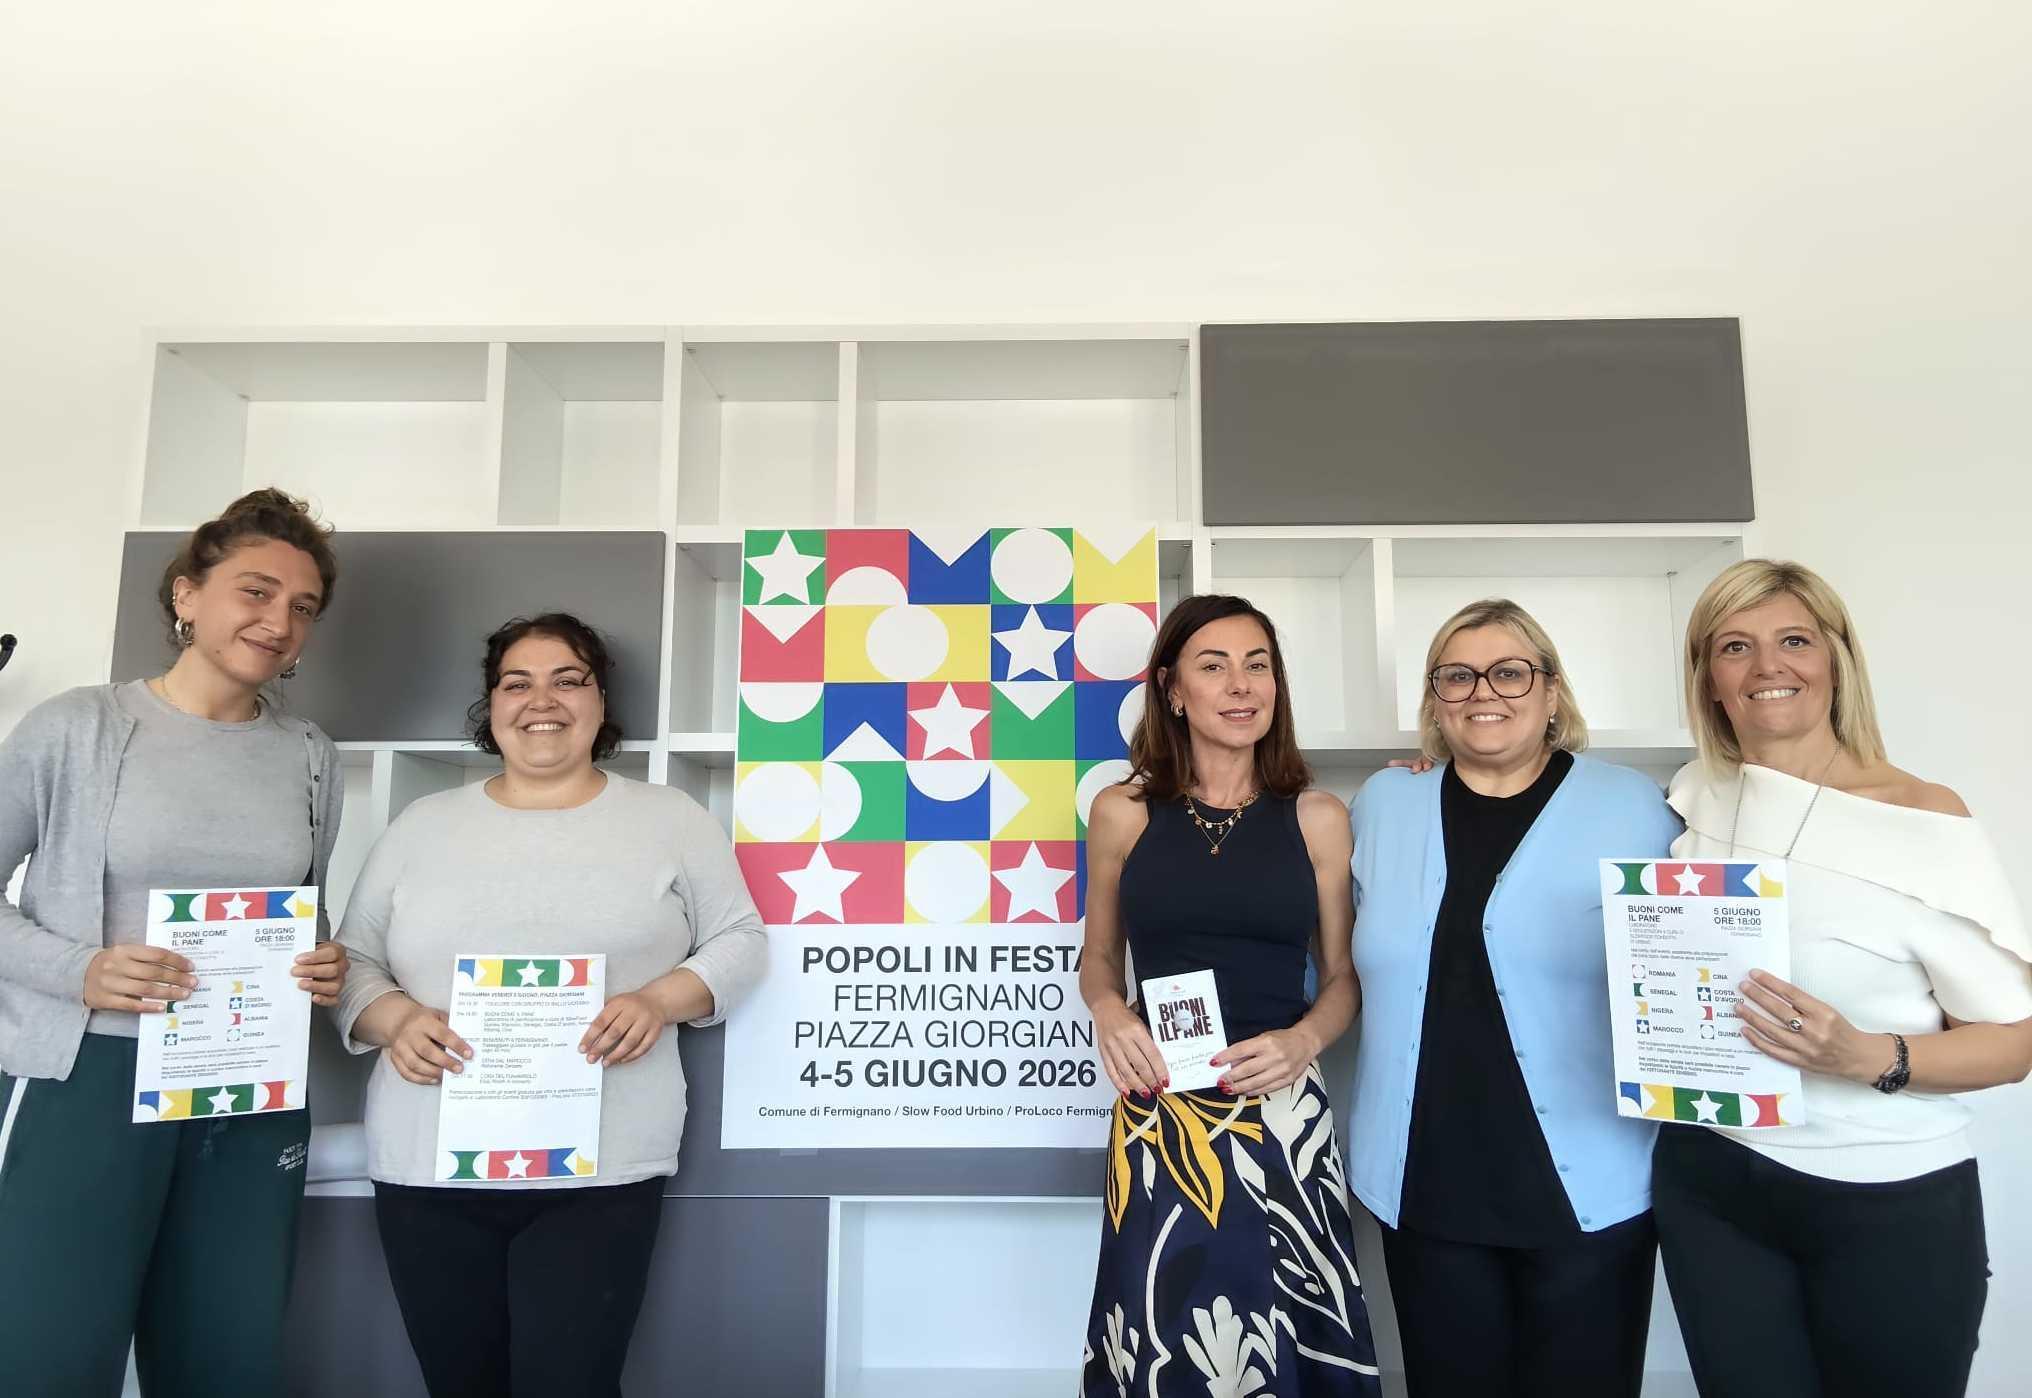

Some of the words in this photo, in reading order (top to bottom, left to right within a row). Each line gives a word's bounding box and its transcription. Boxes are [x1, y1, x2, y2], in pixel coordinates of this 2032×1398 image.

[1627, 904, 1655, 914] BUONI
[1657, 905, 1684, 915] COME
[1713, 907, 1719, 916] 5
[1721, 907, 1761, 917] GIUGNO
[1628, 914, 1636, 922] IL
[1638, 914, 1661, 923] PANE
[1713, 916, 1734, 926] ORE
[1737, 917, 1762, 926] 18:00
[173, 930, 200, 939] BUONI
[202, 929, 228, 937] COME
[262, 927, 296, 935] GIUGNO
[182, 938, 205, 946] PANE
[254, 935, 272, 943] ORE
[275, 934, 295, 942] 18:00
[803, 945, 932, 974] POPOLI
[944, 945, 977, 973] IN
[1648, 969, 1676, 978] ROMANIA
[1712, 973, 1728, 981] CINA
[1649, 988, 1678, 997] SENEGAL
[1713, 988, 1736, 997] COSTA
[834, 983, 1064, 1012] FERMIGNANO
[794, 1020, 914, 1049] PIAZZA
[924, 1019, 1094, 1049] GIORGIAN
[1652, 1025, 1685, 1034] MAROCCO
[799, 1059, 854, 1088] 4-5
[864, 1058, 1007, 1088] GIUGNO
[1018, 1058, 1097, 1088] 2026
[758, 1106, 807, 1117] Comune
[809, 1105, 820, 1117] di
[823, 1105, 892, 1119] Fermignano
[902, 1105, 930, 1117] Slow
[933, 1105, 962, 1116] Food
[965, 1105, 1004, 1117] Urbino
[1014, 1105, 1064, 1117] ProLoco
[1066, 1105, 1113, 1119] Fermign
